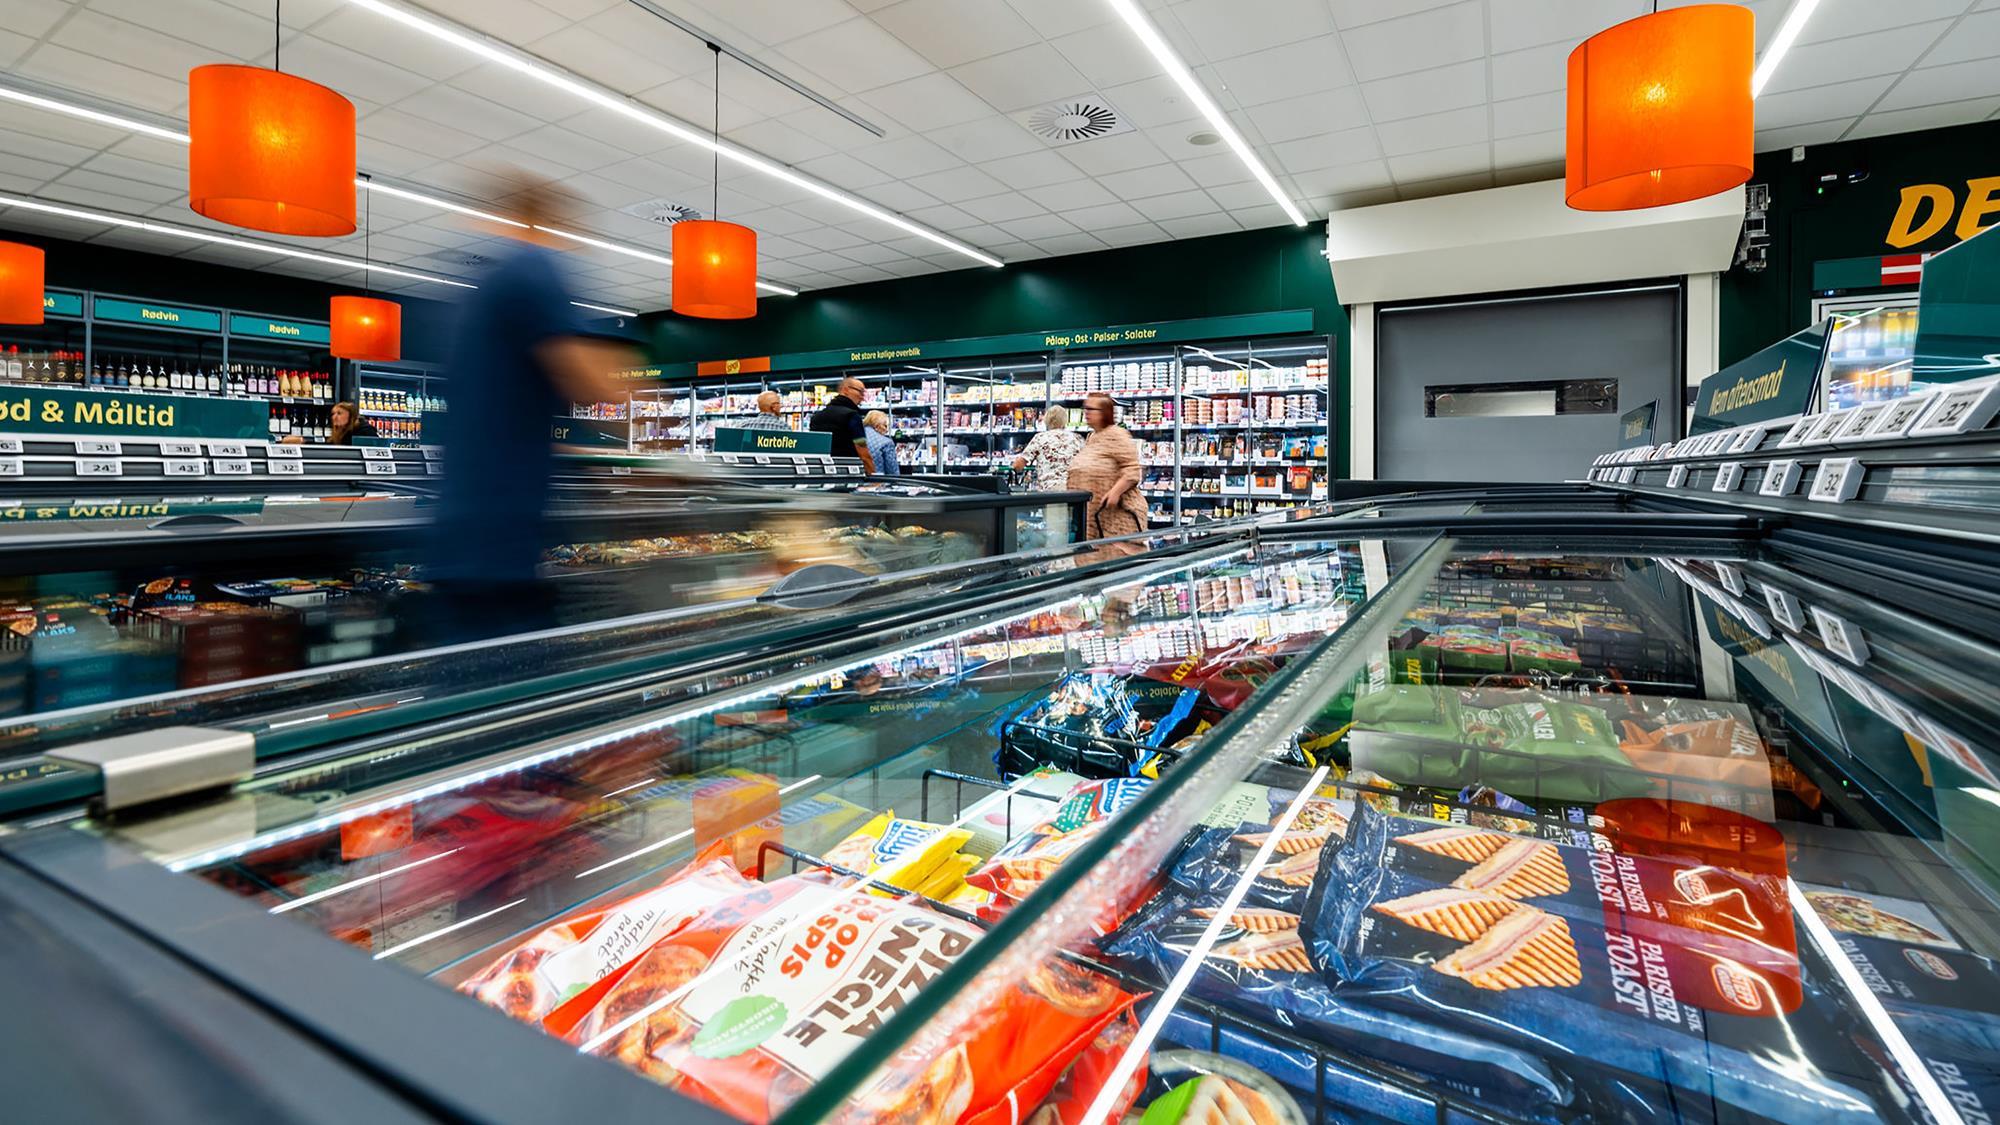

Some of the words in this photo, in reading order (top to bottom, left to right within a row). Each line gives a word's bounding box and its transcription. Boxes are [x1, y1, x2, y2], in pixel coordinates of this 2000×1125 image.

[142, 309, 179, 321] Rødvin
[269, 324, 300, 336] Rødvin
[1045, 335, 1070, 346] Pålæg
[1075, 334, 1088, 344] Ost
[1093, 332, 1120, 342] Pølser
[1125, 329, 1157, 340] Salater
[851, 352, 861, 361] Det
[861, 351, 877, 360] store
[896, 347, 921, 357] overblik
[41, 400, 64, 422] &
[74, 399, 174, 427] Måltid
[1709, 389, 1729, 416] Nem
[1727, 359, 1786, 411] aftensmad
[757, 435, 798, 449] Kartofler
[1587, 850, 1626, 911] TOAST
[1615, 855, 1651, 914] PARISER
[594, 910, 655, 979] madpakke
[597, 914, 632, 957] parat
[741, 917, 788, 992] mapakke
[780, 914, 839, 979] SPIS
[825, 923, 859, 969] OP
[783, 917, 936, 1048] SNEGLE
[842, 927, 974, 1040] PIZZA
[1605, 932, 1650, 1018] TOAST
[1639, 939, 1681, 1024] PARISER
